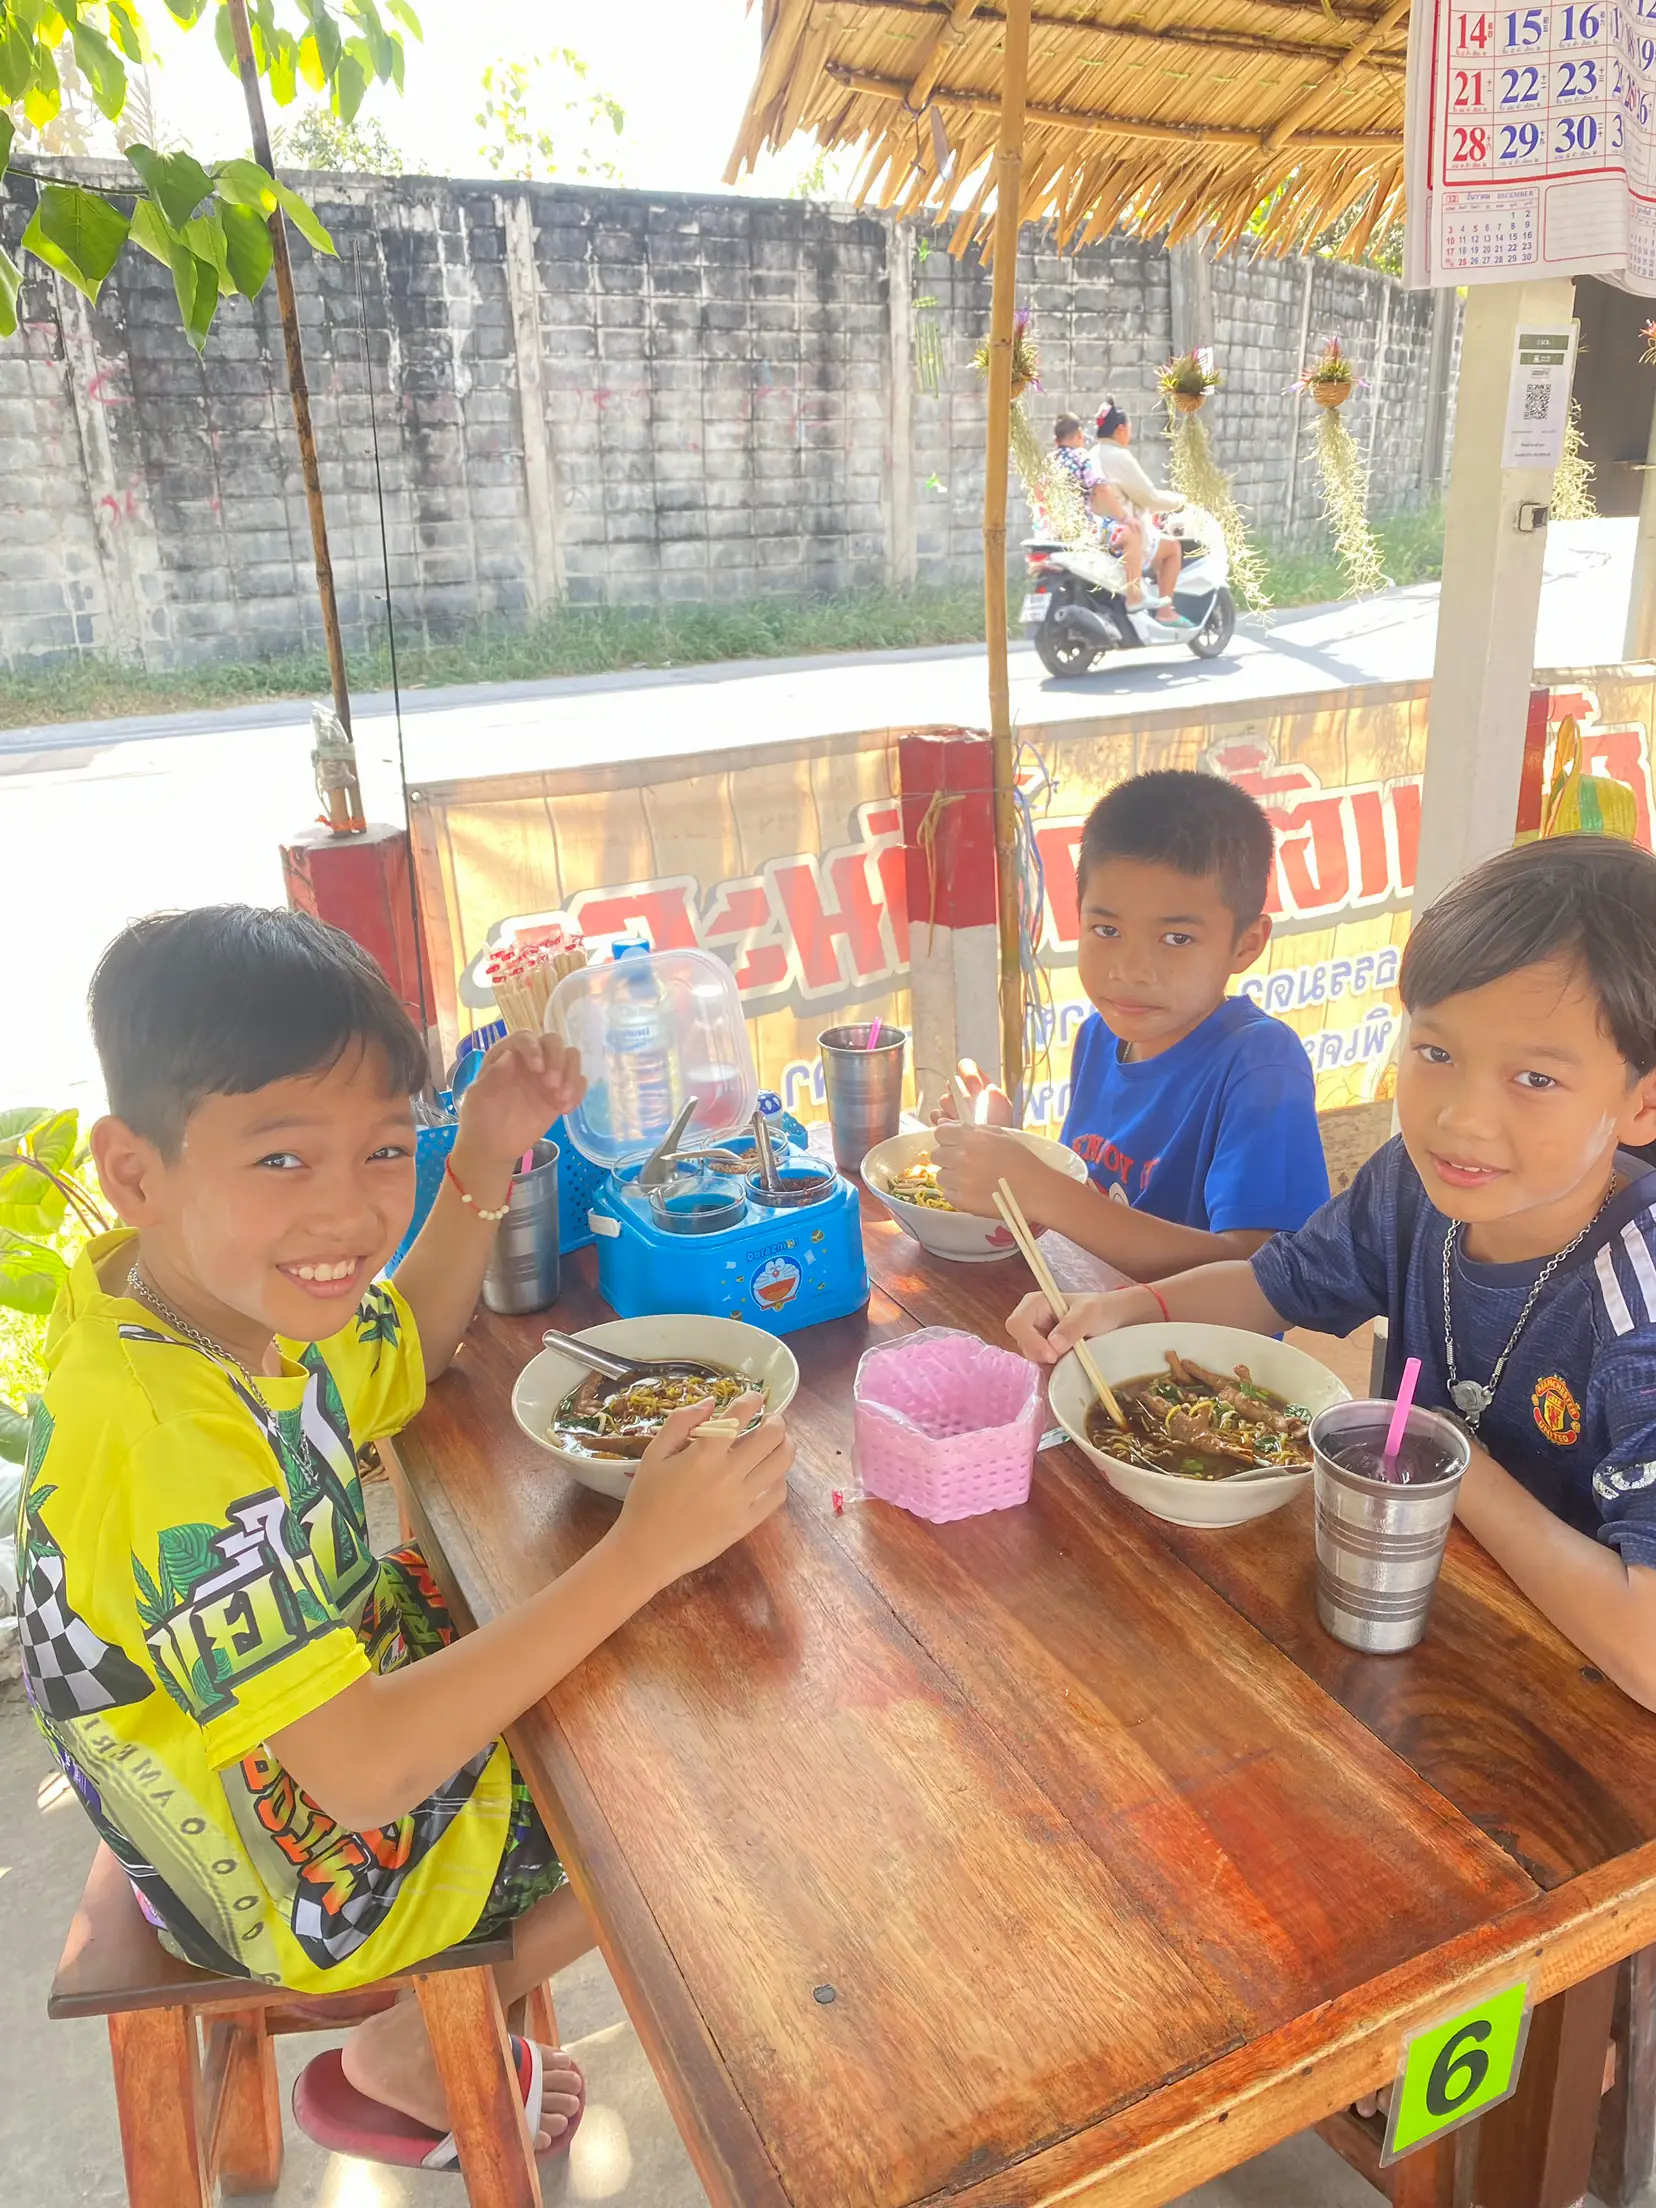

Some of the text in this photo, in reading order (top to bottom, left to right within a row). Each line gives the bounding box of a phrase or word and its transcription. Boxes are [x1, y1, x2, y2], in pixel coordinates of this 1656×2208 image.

[1456, 13, 1488, 49] 14
[1503, 8, 1543, 47] 15
[1561, 2, 1600, 41] 16
[1453, 71, 1484, 106] 21
[1500, 66, 1539, 104] 22
[1556, 60, 1597, 98] 23
[1452, 127, 1486, 162] 28
[1499, 122, 1539, 160] 29
[1554, 115, 1597, 153] 30
[1448, 195, 1457, 203] 12
[1497, 190, 1534, 199] DECEMBER
[1525, 210, 1531, 218] 2
[1448, 226, 1453, 234] 3
[1485, 223, 1490, 231] 6
[1511, 222, 1515, 230] 8
[1525, 221, 1530, 229] 9
[1447, 237, 1454, 245] 10
[1471, 235, 1479, 243] 12
[1496, 234, 1503, 242] 14
[1509, 233, 1517, 241] 15
[1523, 231, 1532, 239] 16
[1447, 248, 1454, 256] 17
[1471, 246, 1478, 254] 19
[1495, 245, 1503, 253] 21
[1508, 244, 1517, 252] 22
[1522, 242, 1532, 250] 23
[1458, 258, 1466, 266] 25
[1471, 257, 1478, 265] 26
[1482, 256, 1490, 264] 27
[1522, 253, 1531, 261] 30
[1537, 1378, 1579, 1417] MANCHESTER
[1538, 1420, 1570, 1444] UNITED
[1425, 2020, 1492, 2117] 6
